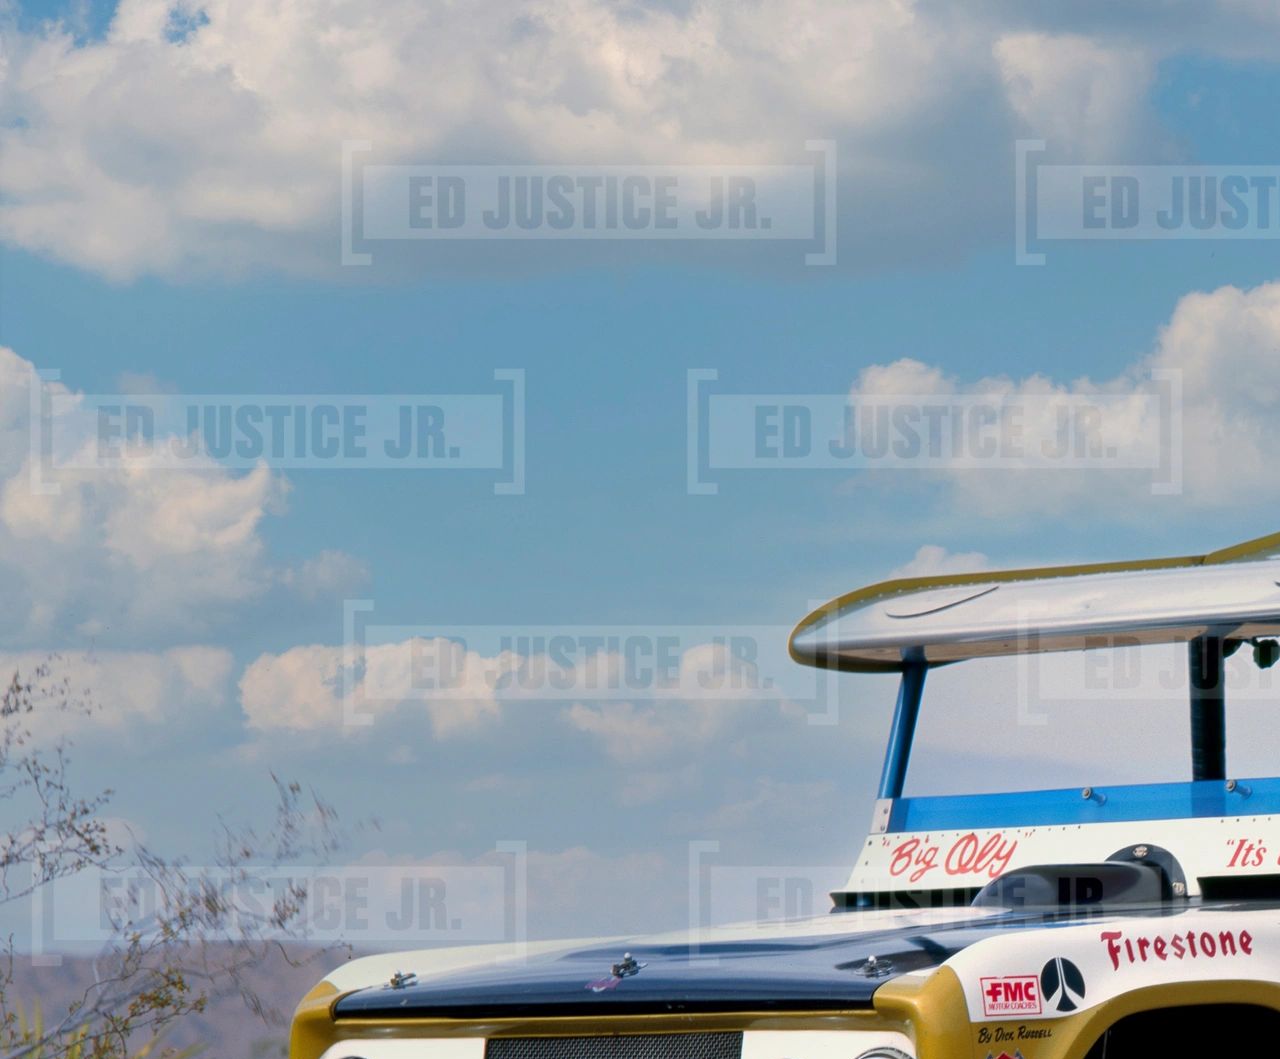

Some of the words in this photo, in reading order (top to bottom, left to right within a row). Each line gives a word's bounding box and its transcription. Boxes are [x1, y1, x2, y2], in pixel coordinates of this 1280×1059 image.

[1100, 928, 1253, 971] Firestone
[986, 982, 1036, 1002] FMC
[978, 1027, 993, 1044] By
